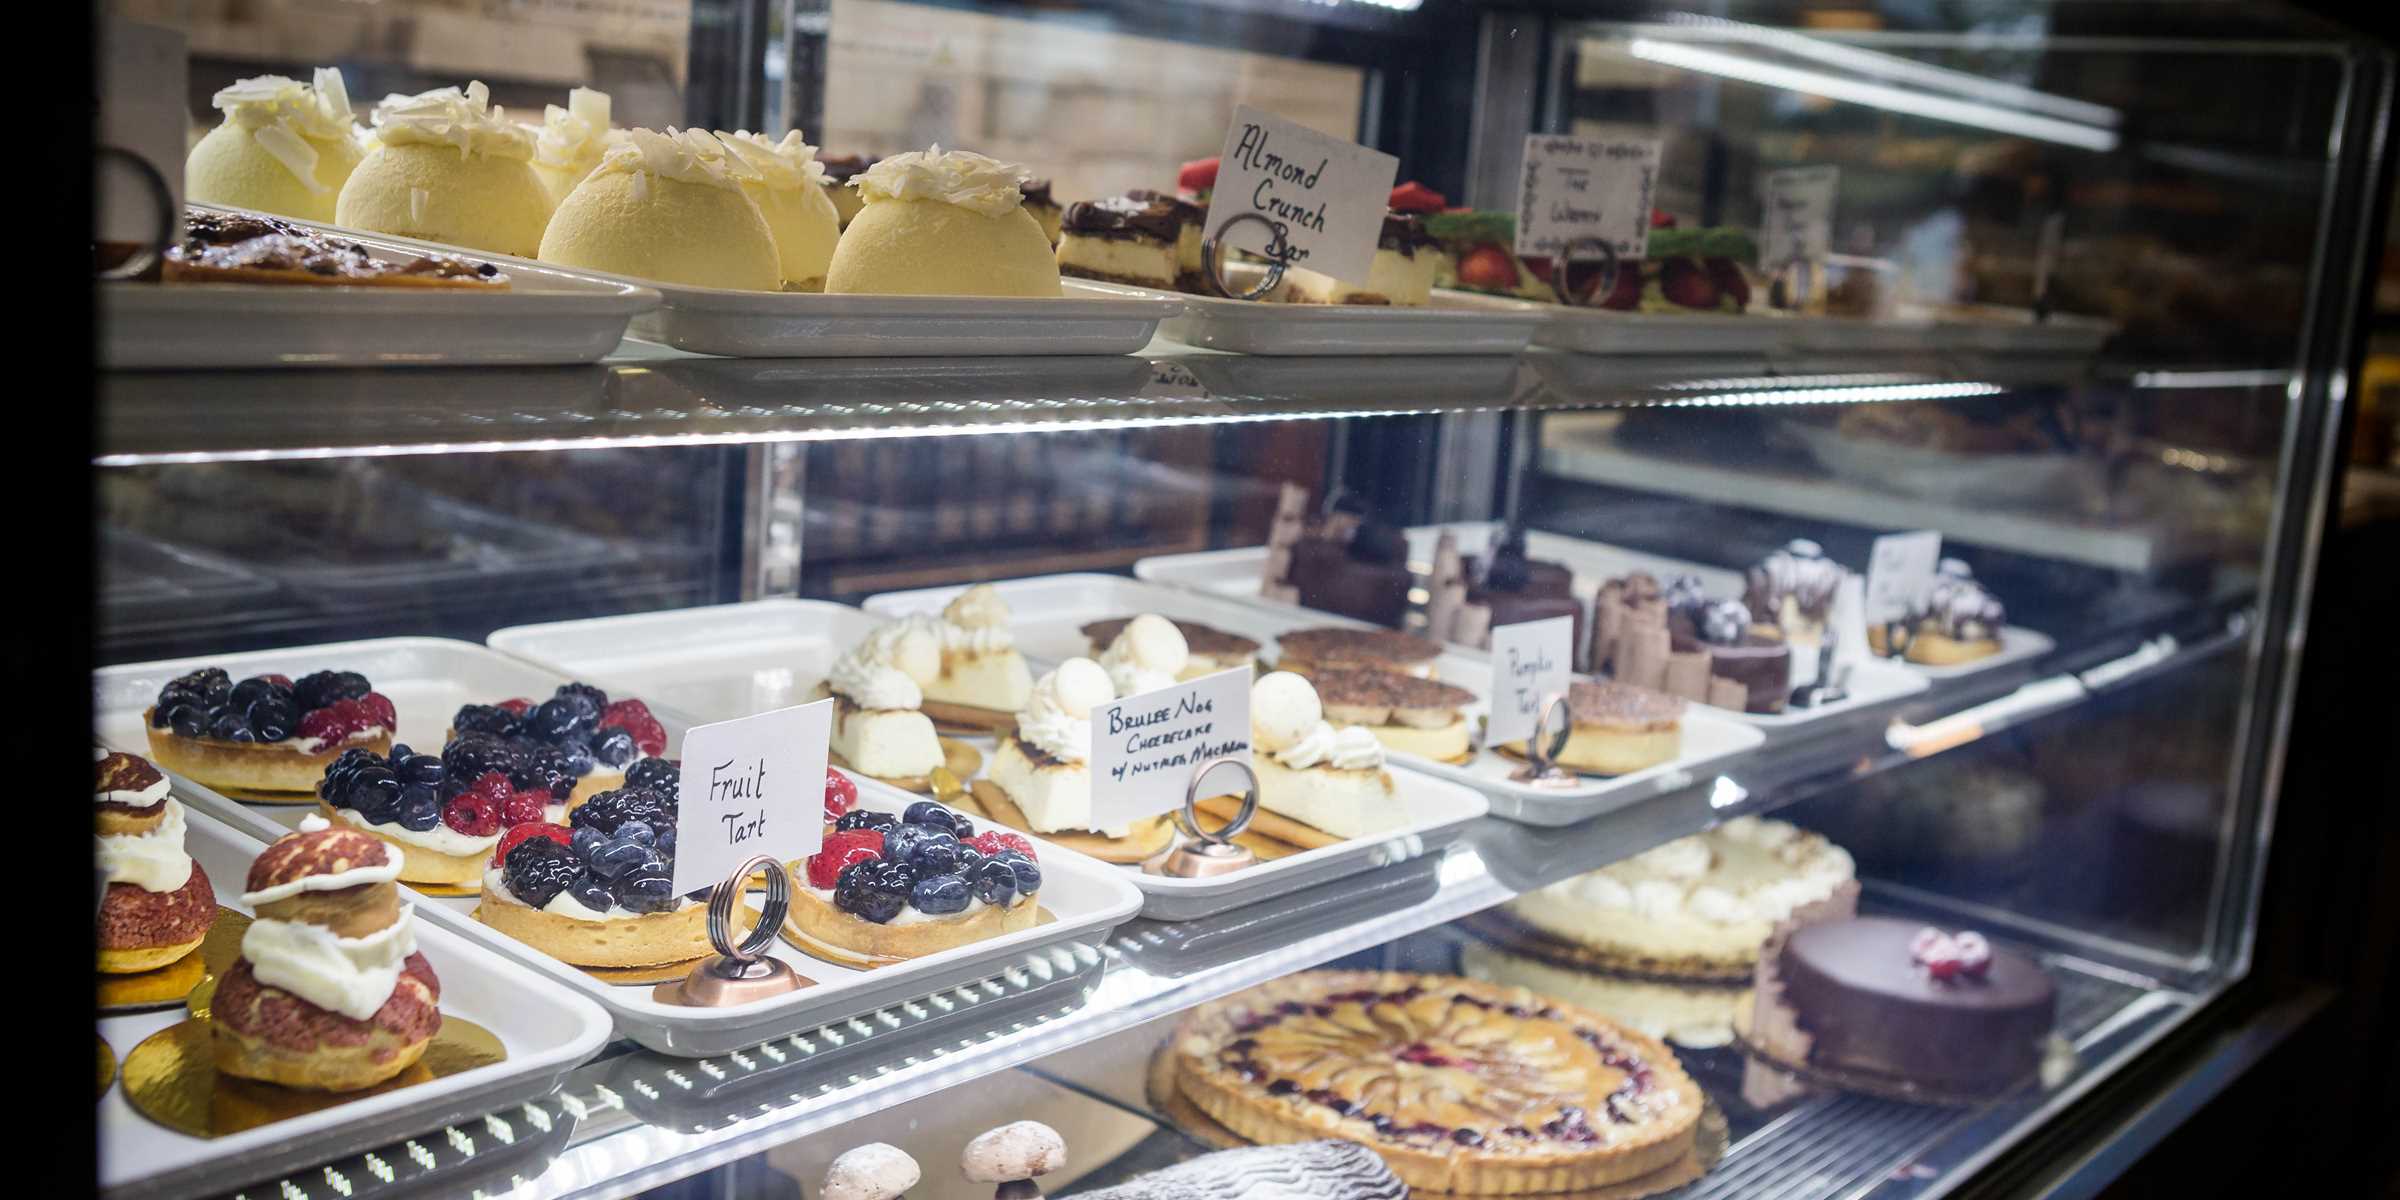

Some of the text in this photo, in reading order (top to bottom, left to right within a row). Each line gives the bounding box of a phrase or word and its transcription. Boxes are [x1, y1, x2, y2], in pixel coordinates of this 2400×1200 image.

[1234, 123, 1328, 189] Almond
[1252, 177, 1326, 233] Crunch
[1264, 221, 1310, 261] Bar
[709, 757, 766, 801] Fruit
[721, 808, 766, 845] Tart
